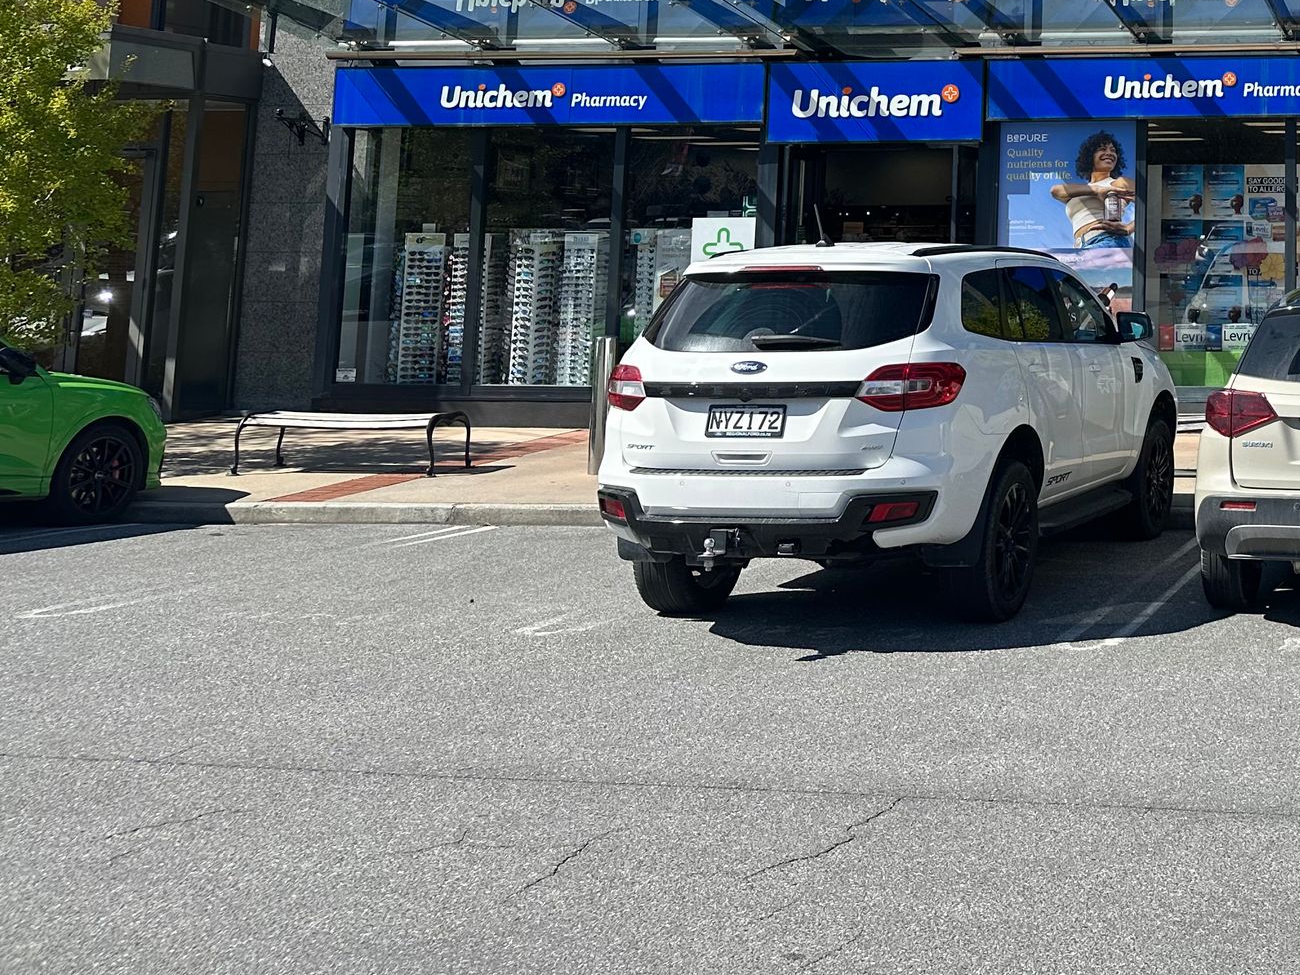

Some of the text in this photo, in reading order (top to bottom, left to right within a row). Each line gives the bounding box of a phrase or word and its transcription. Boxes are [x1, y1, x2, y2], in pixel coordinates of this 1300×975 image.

[1104, 73, 1224, 99] Unichem
[440, 83, 647, 110] Unichem Pharmacy
[791, 86, 943, 118] Unichem
[1007, 148, 1045, 158] Quality
[1007, 159, 1069, 169] nutrients for
[1006, 172, 1041, 182] quality
[1043, 171, 1055, 181] of
[709, 410, 781, 431] NYZ172
[1242, 441, 1273, 449] SUZUKI
[1045, 471, 1073, 487] SPORT
